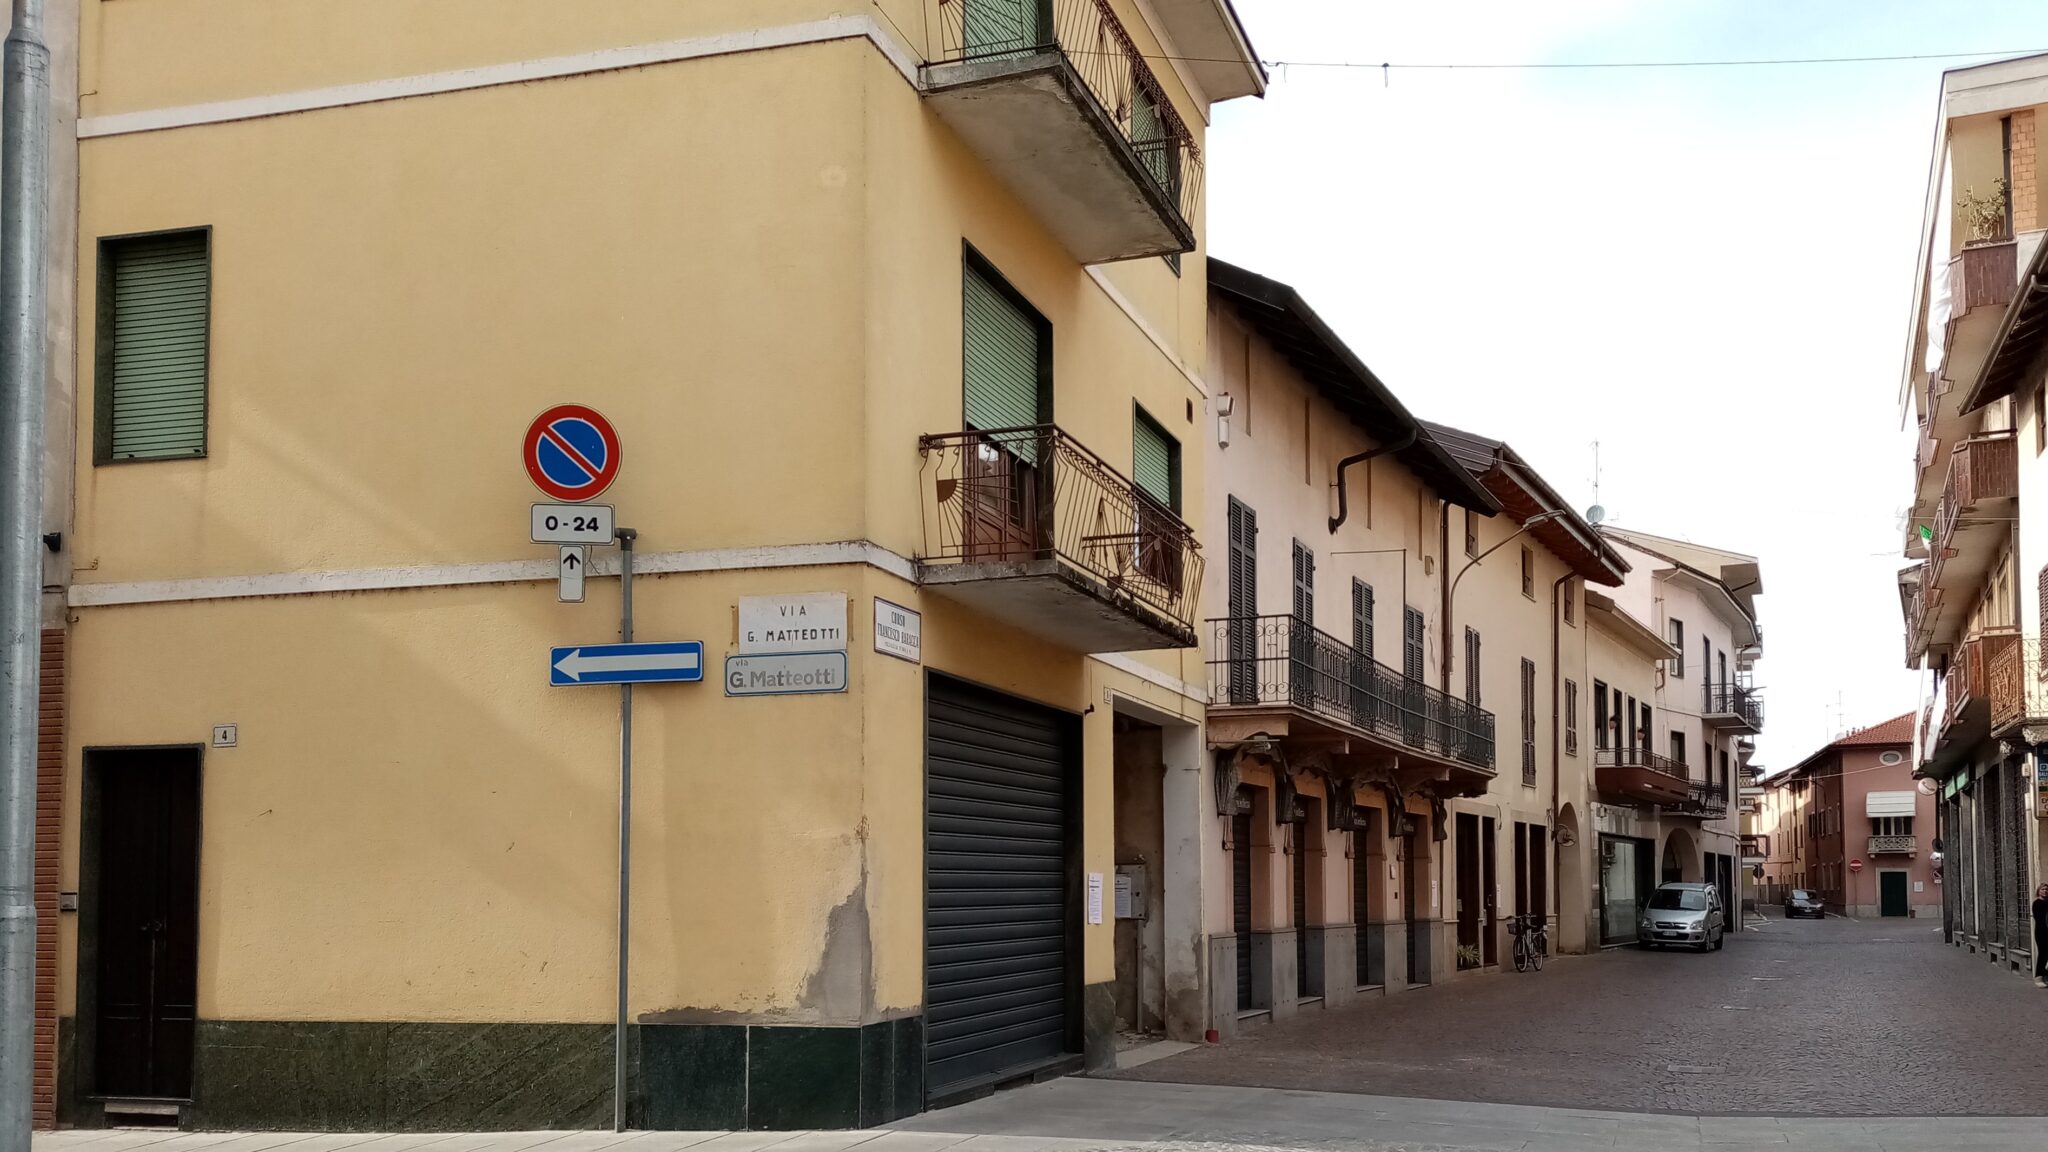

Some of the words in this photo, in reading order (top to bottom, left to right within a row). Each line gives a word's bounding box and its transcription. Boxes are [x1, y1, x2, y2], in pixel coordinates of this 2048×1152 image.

[780, 605, 807, 617] VIA
[891, 611, 905, 628] CORSO
[747, 631, 758, 643] G.
[766, 627, 840, 642] MATTEOTTI
[735, 659, 749, 667] via
[729, 671, 747, 688] G.
[750, 668, 836, 688] Matteotti
[221, 729, 228, 742] 4
